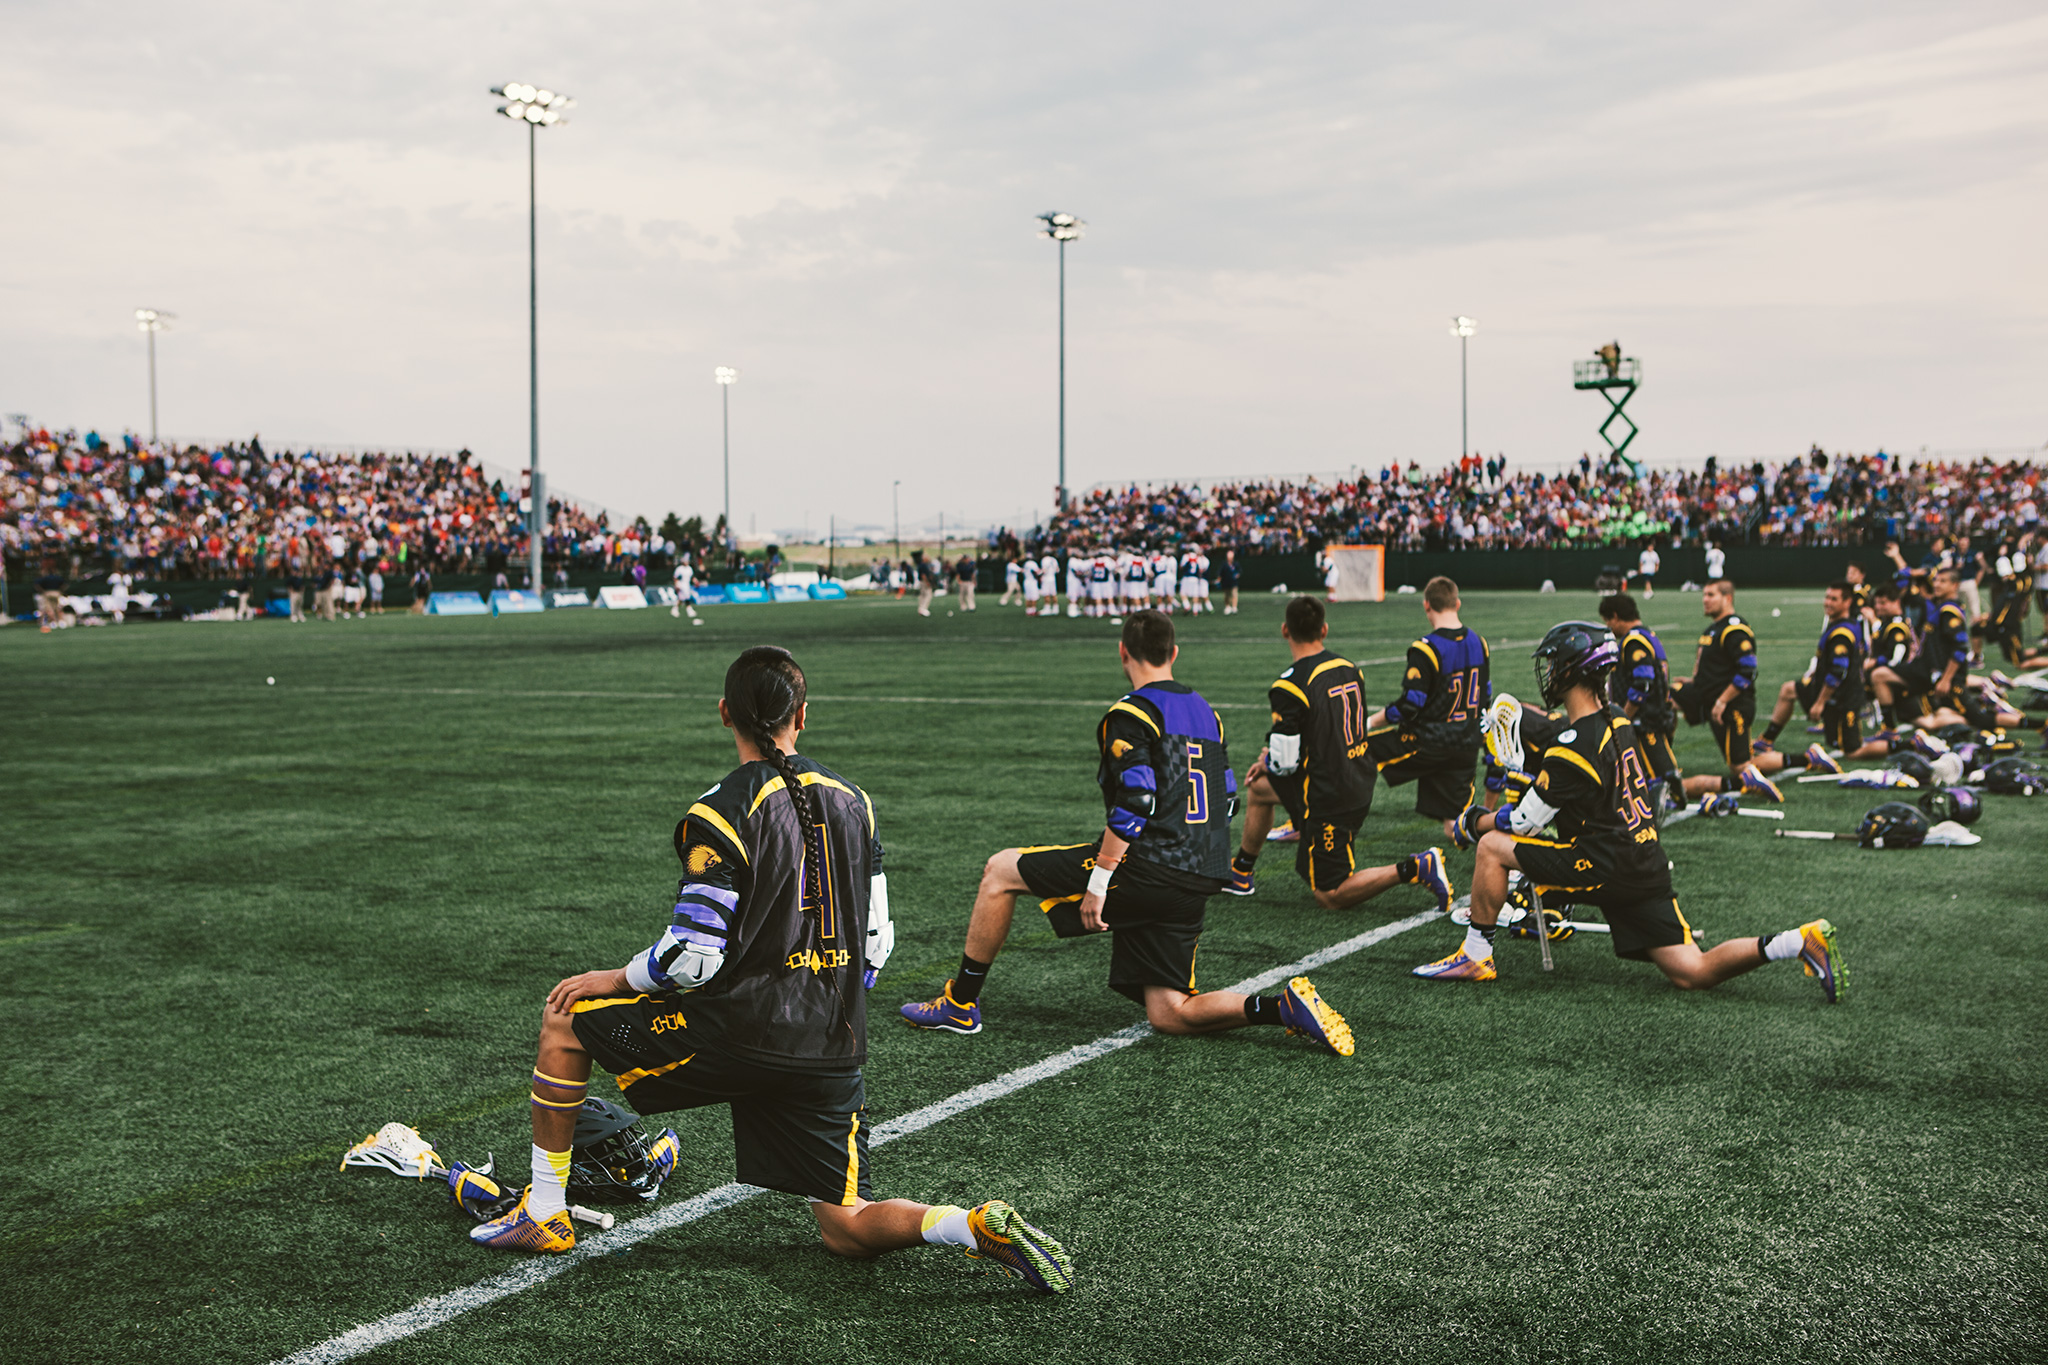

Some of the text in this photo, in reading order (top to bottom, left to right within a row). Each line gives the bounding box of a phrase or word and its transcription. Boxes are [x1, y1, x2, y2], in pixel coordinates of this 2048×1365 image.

[1328, 681, 1364, 746] 77
[1447, 668, 1480, 723] 24
[1185, 741, 1209, 824] 5
[798, 823, 835, 938] 4
[544, 1218, 573, 1241] NIKE
